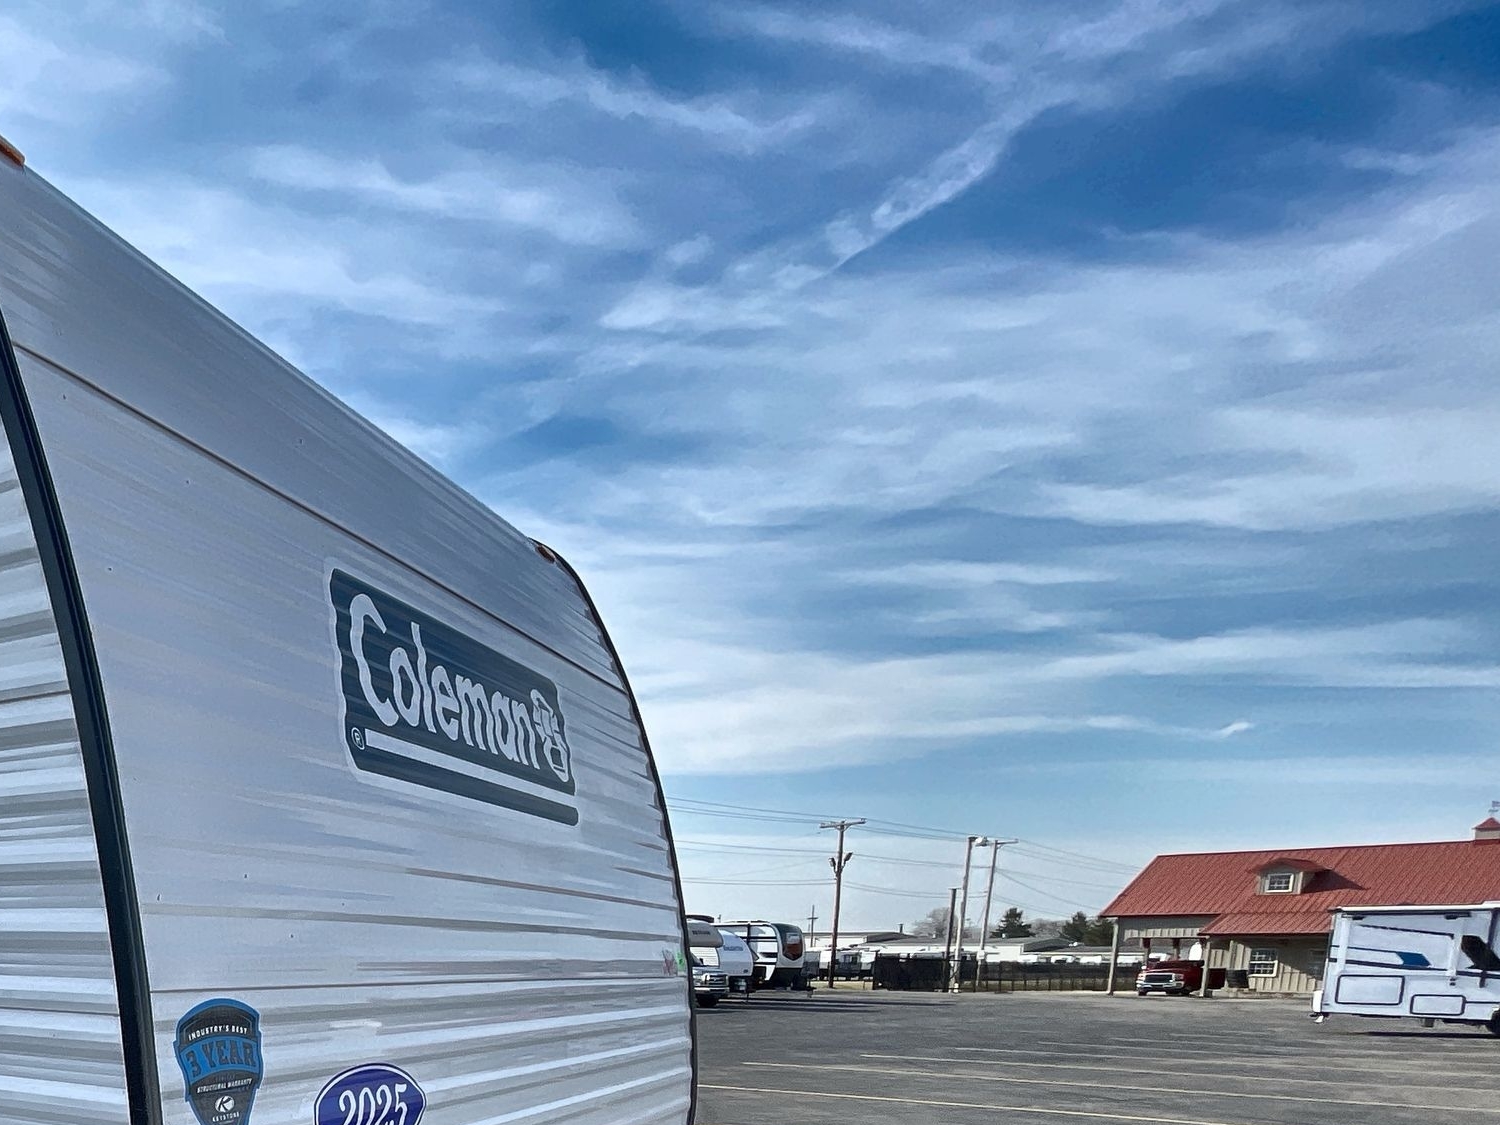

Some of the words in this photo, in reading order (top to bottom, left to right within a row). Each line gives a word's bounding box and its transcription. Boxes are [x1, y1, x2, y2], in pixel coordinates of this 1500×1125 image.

[350, 593, 540, 770] Coleman
[188, 1024, 230, 1041] INDUSTRY'S
[231, 1025, 248, 1035] BEST
[185, 1050, 202, 1078] 3
[201, 1039, 257, 1069] YEAR
[212, 1111, 240, 1123] KEYSTONE
